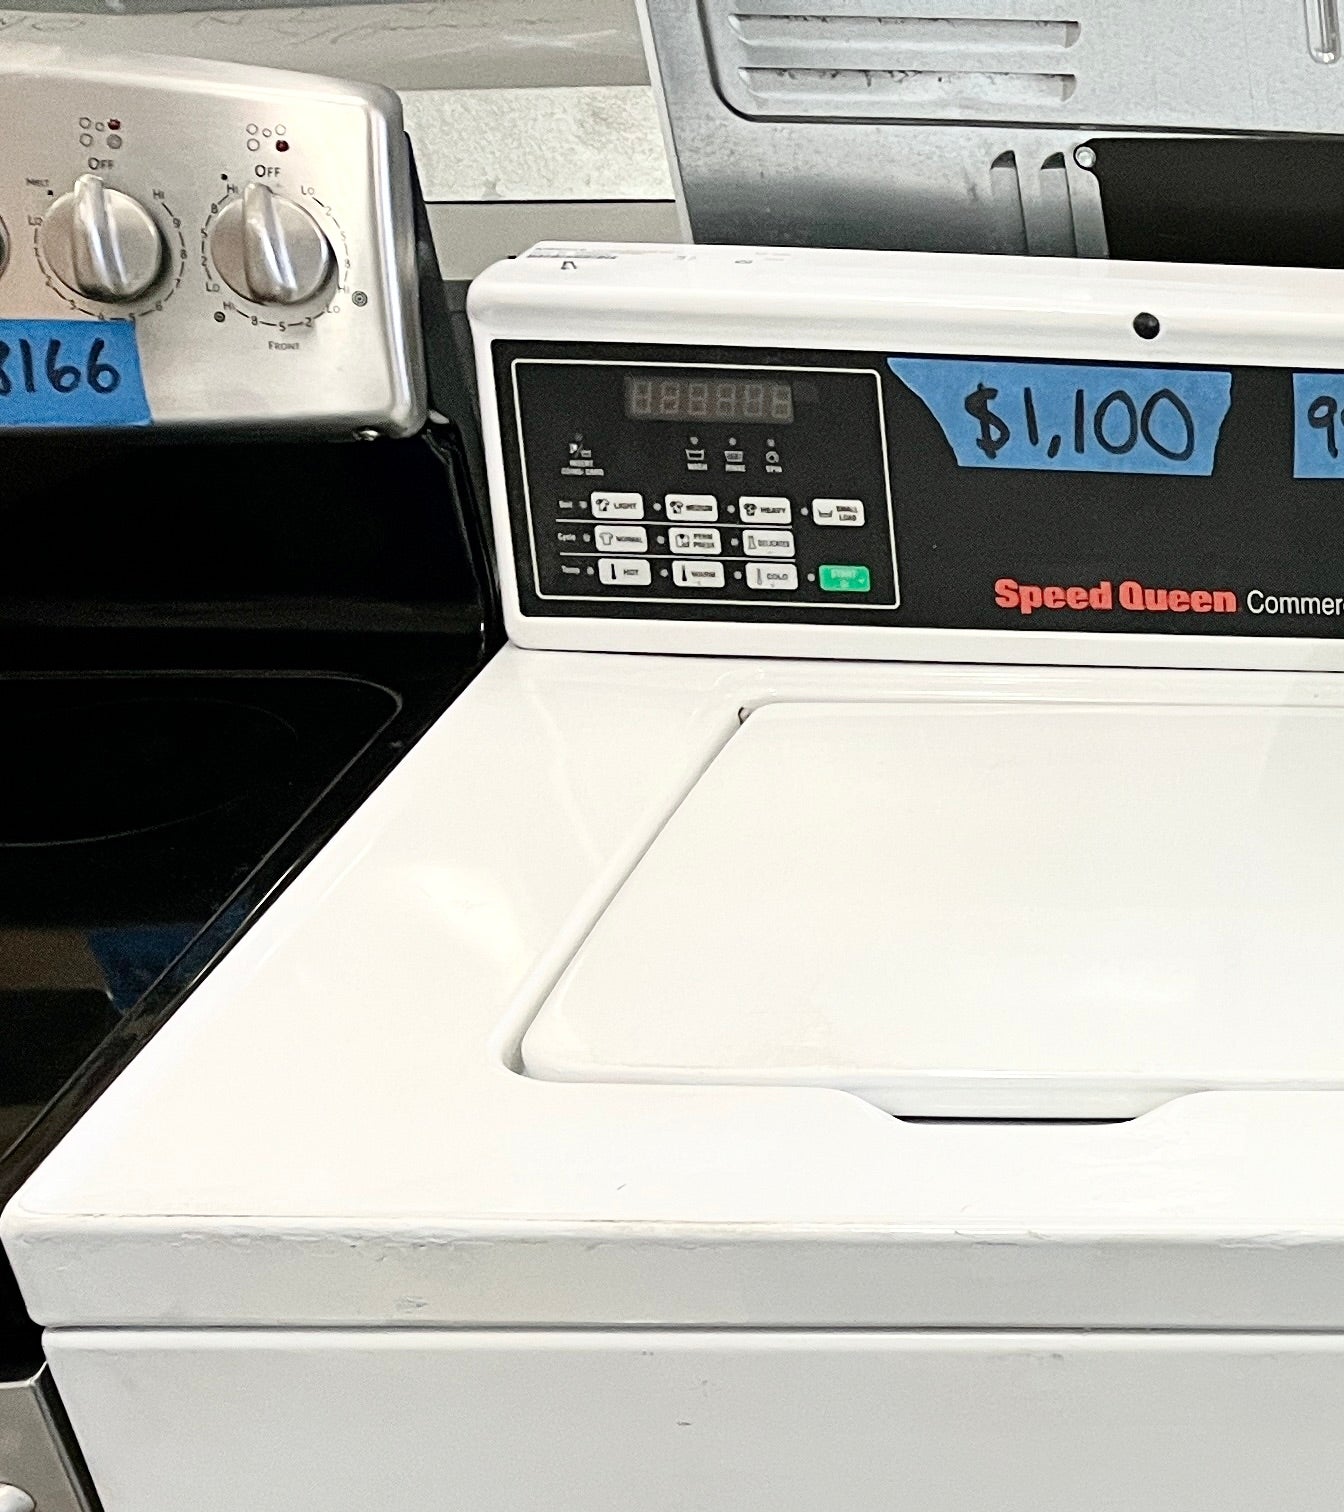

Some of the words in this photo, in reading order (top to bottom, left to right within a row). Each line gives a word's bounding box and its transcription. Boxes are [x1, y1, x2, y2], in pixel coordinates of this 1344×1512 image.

[255, 165, 280, 177] OFF
[279, 322, 286, 331] 5
[305, 317, 312, 327] 2
[269, 341, 300, 350] FRONT
[965, 383, 1194, 461] $1,100
[994, 579, 1112, 614] Speed
[1119, 581, 1237, 613] Queen
